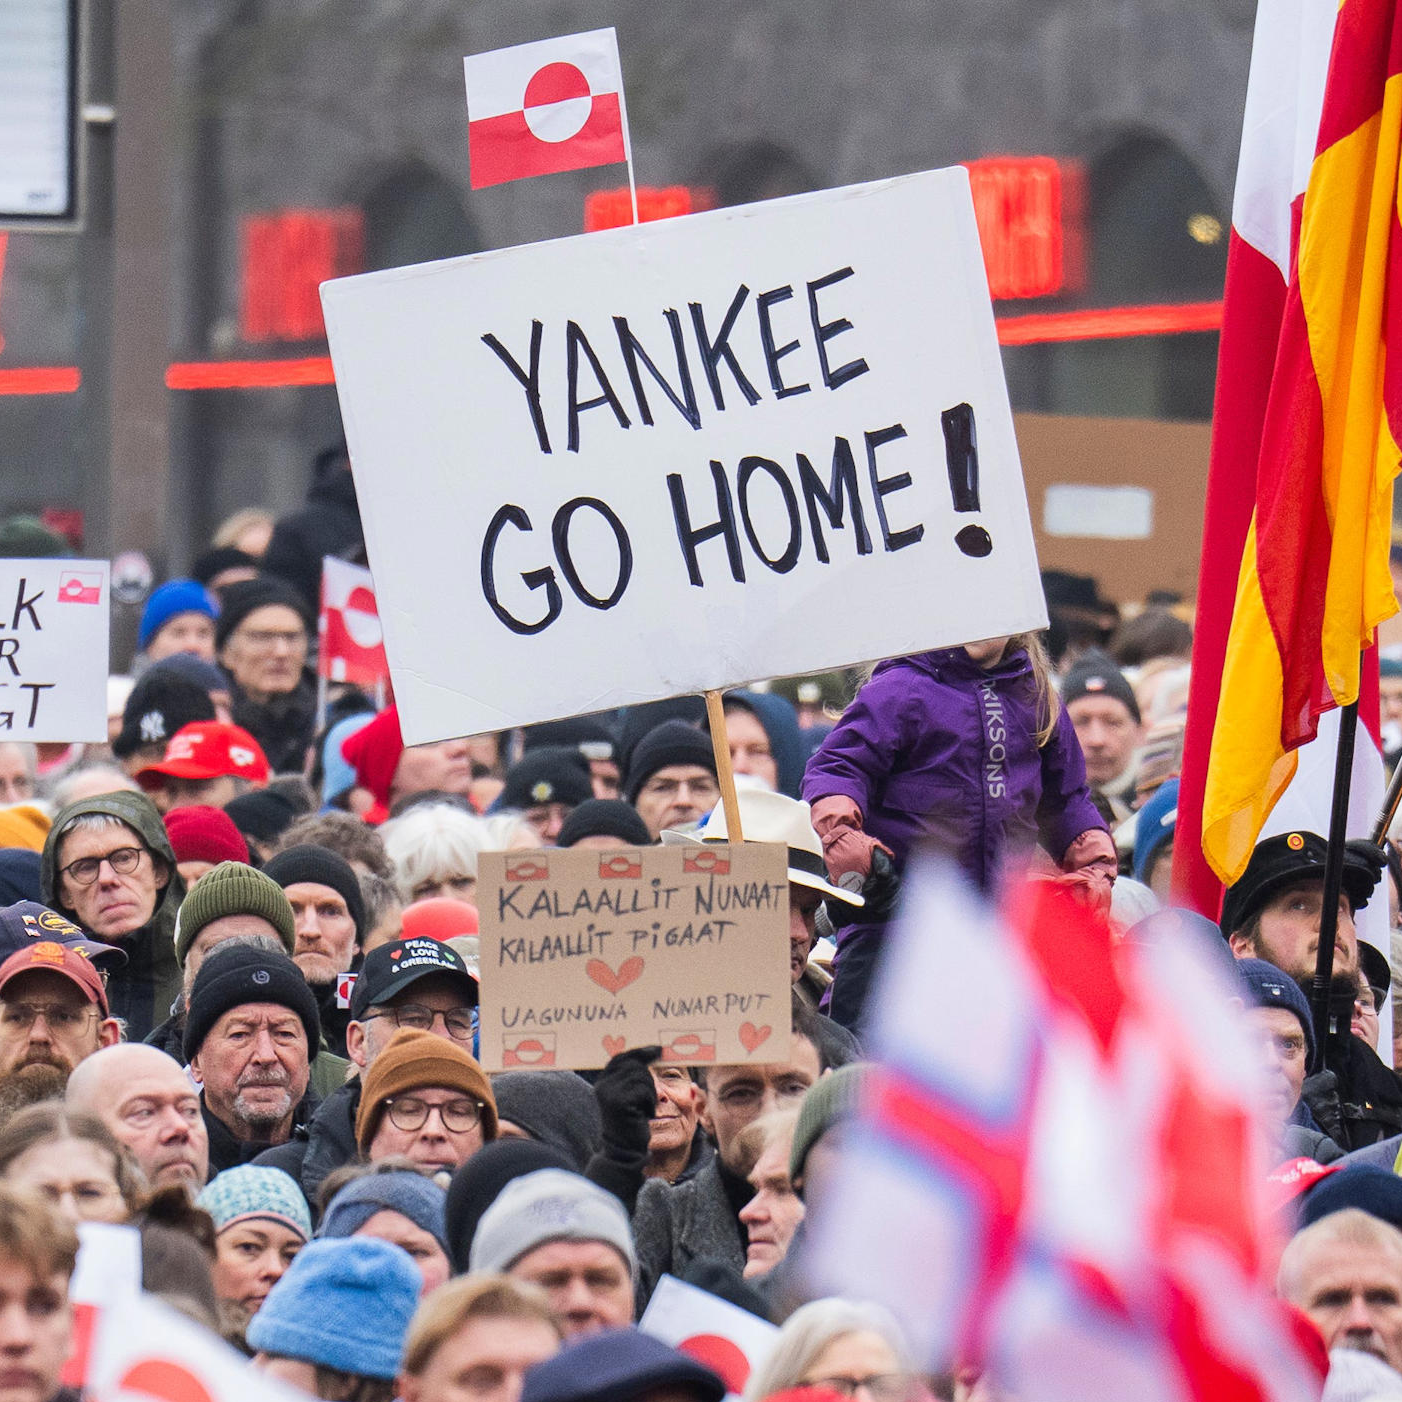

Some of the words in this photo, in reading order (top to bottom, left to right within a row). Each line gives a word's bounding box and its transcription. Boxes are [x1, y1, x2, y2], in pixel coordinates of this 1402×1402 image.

[481, 266, 871, 455] YANKEE
[481, 497, 632, 635] GO
[665, 402, 994, 587] HOME!
[694, 874, 787, 916] NUNAAT
[404, 939, 440, 951] PEACE
[410, 948, 440, 957] LOVE
